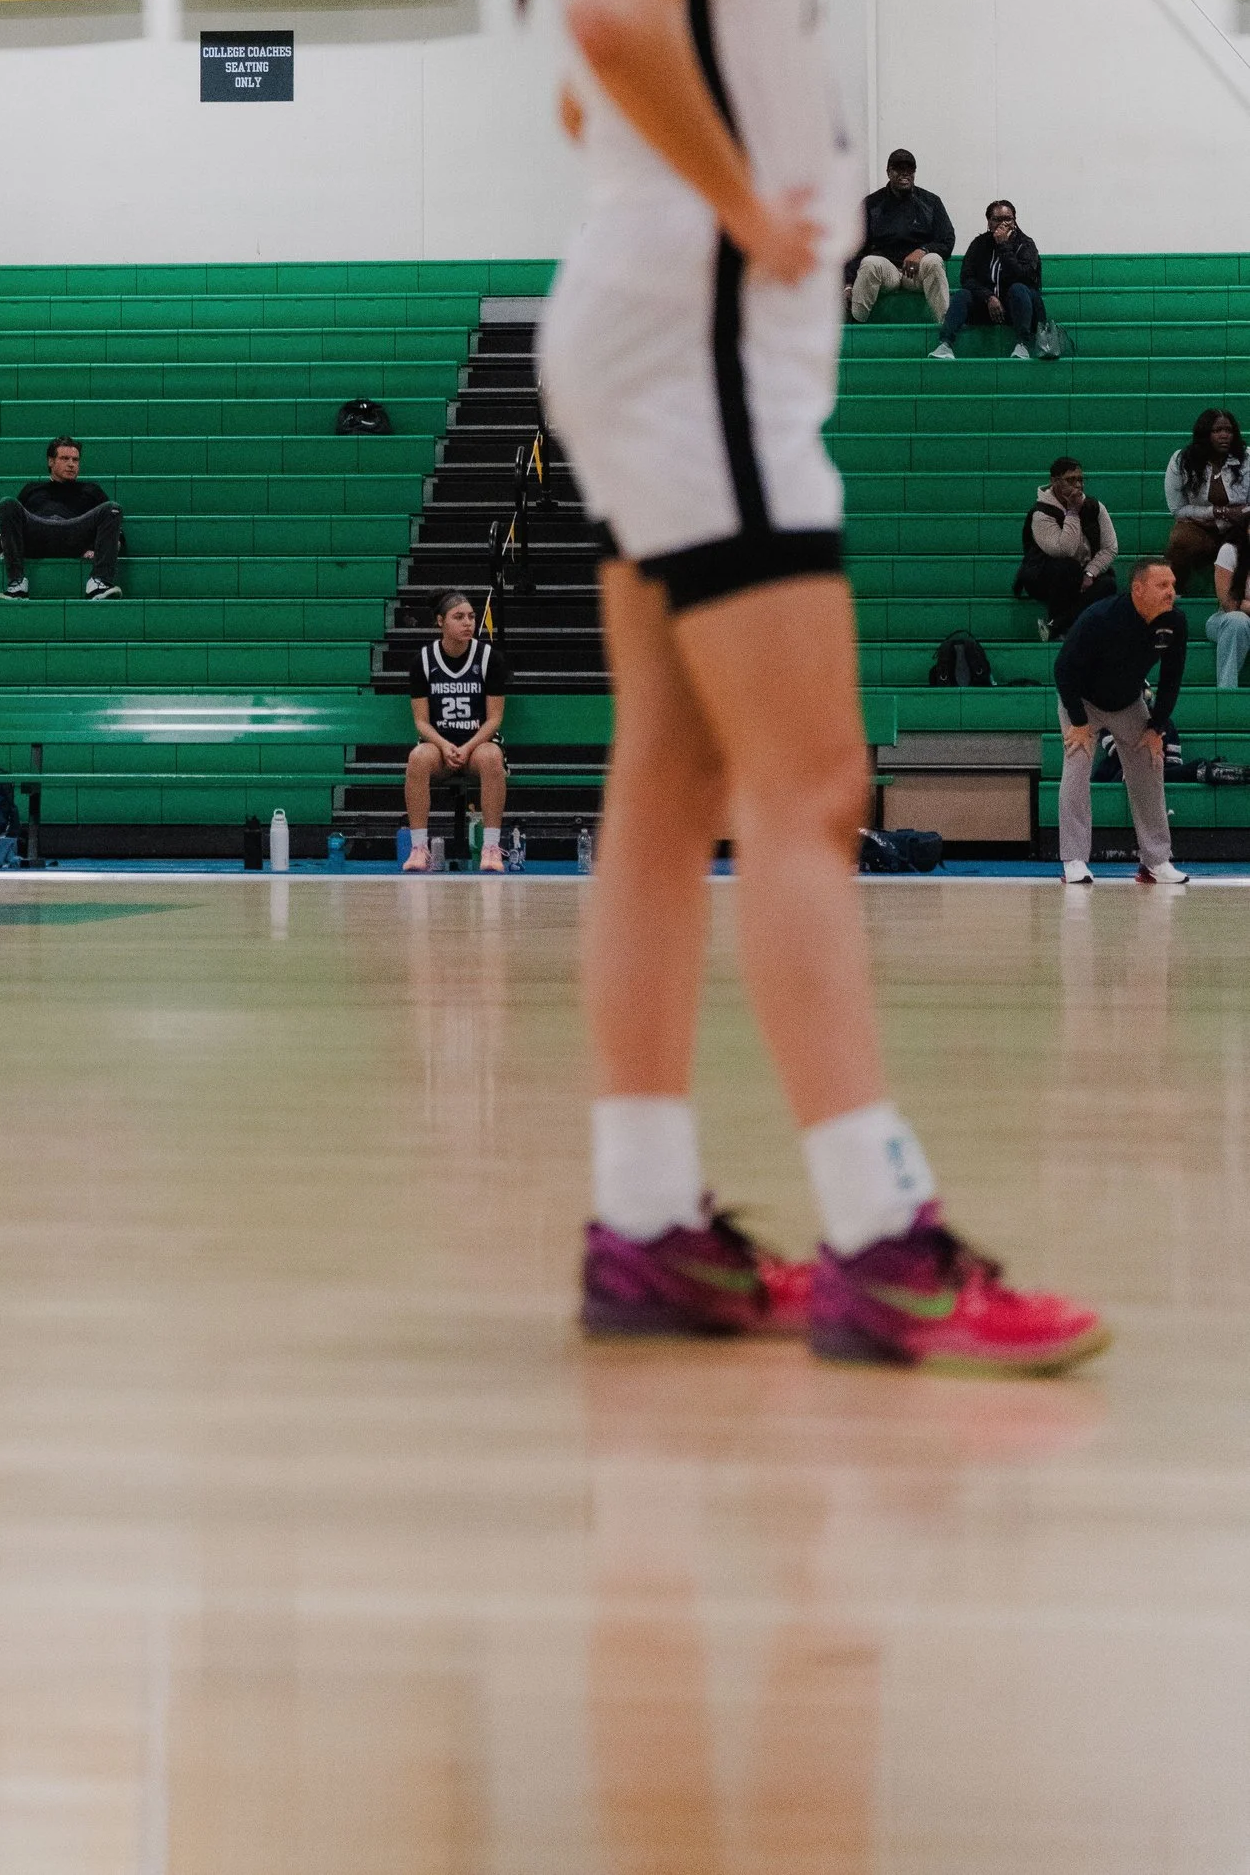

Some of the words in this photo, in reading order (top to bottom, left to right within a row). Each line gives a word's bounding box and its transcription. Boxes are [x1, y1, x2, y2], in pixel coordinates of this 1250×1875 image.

[202, 46, 245, 57] COLLEGE
[247, 46, 292, 57] COACHES
[225, 61, 269, 73] SEATING
[235, 77, 262, 87] ONLY
[430, 682, 482, 695] MISSOURI
[441, 696, 471, 720] 25
